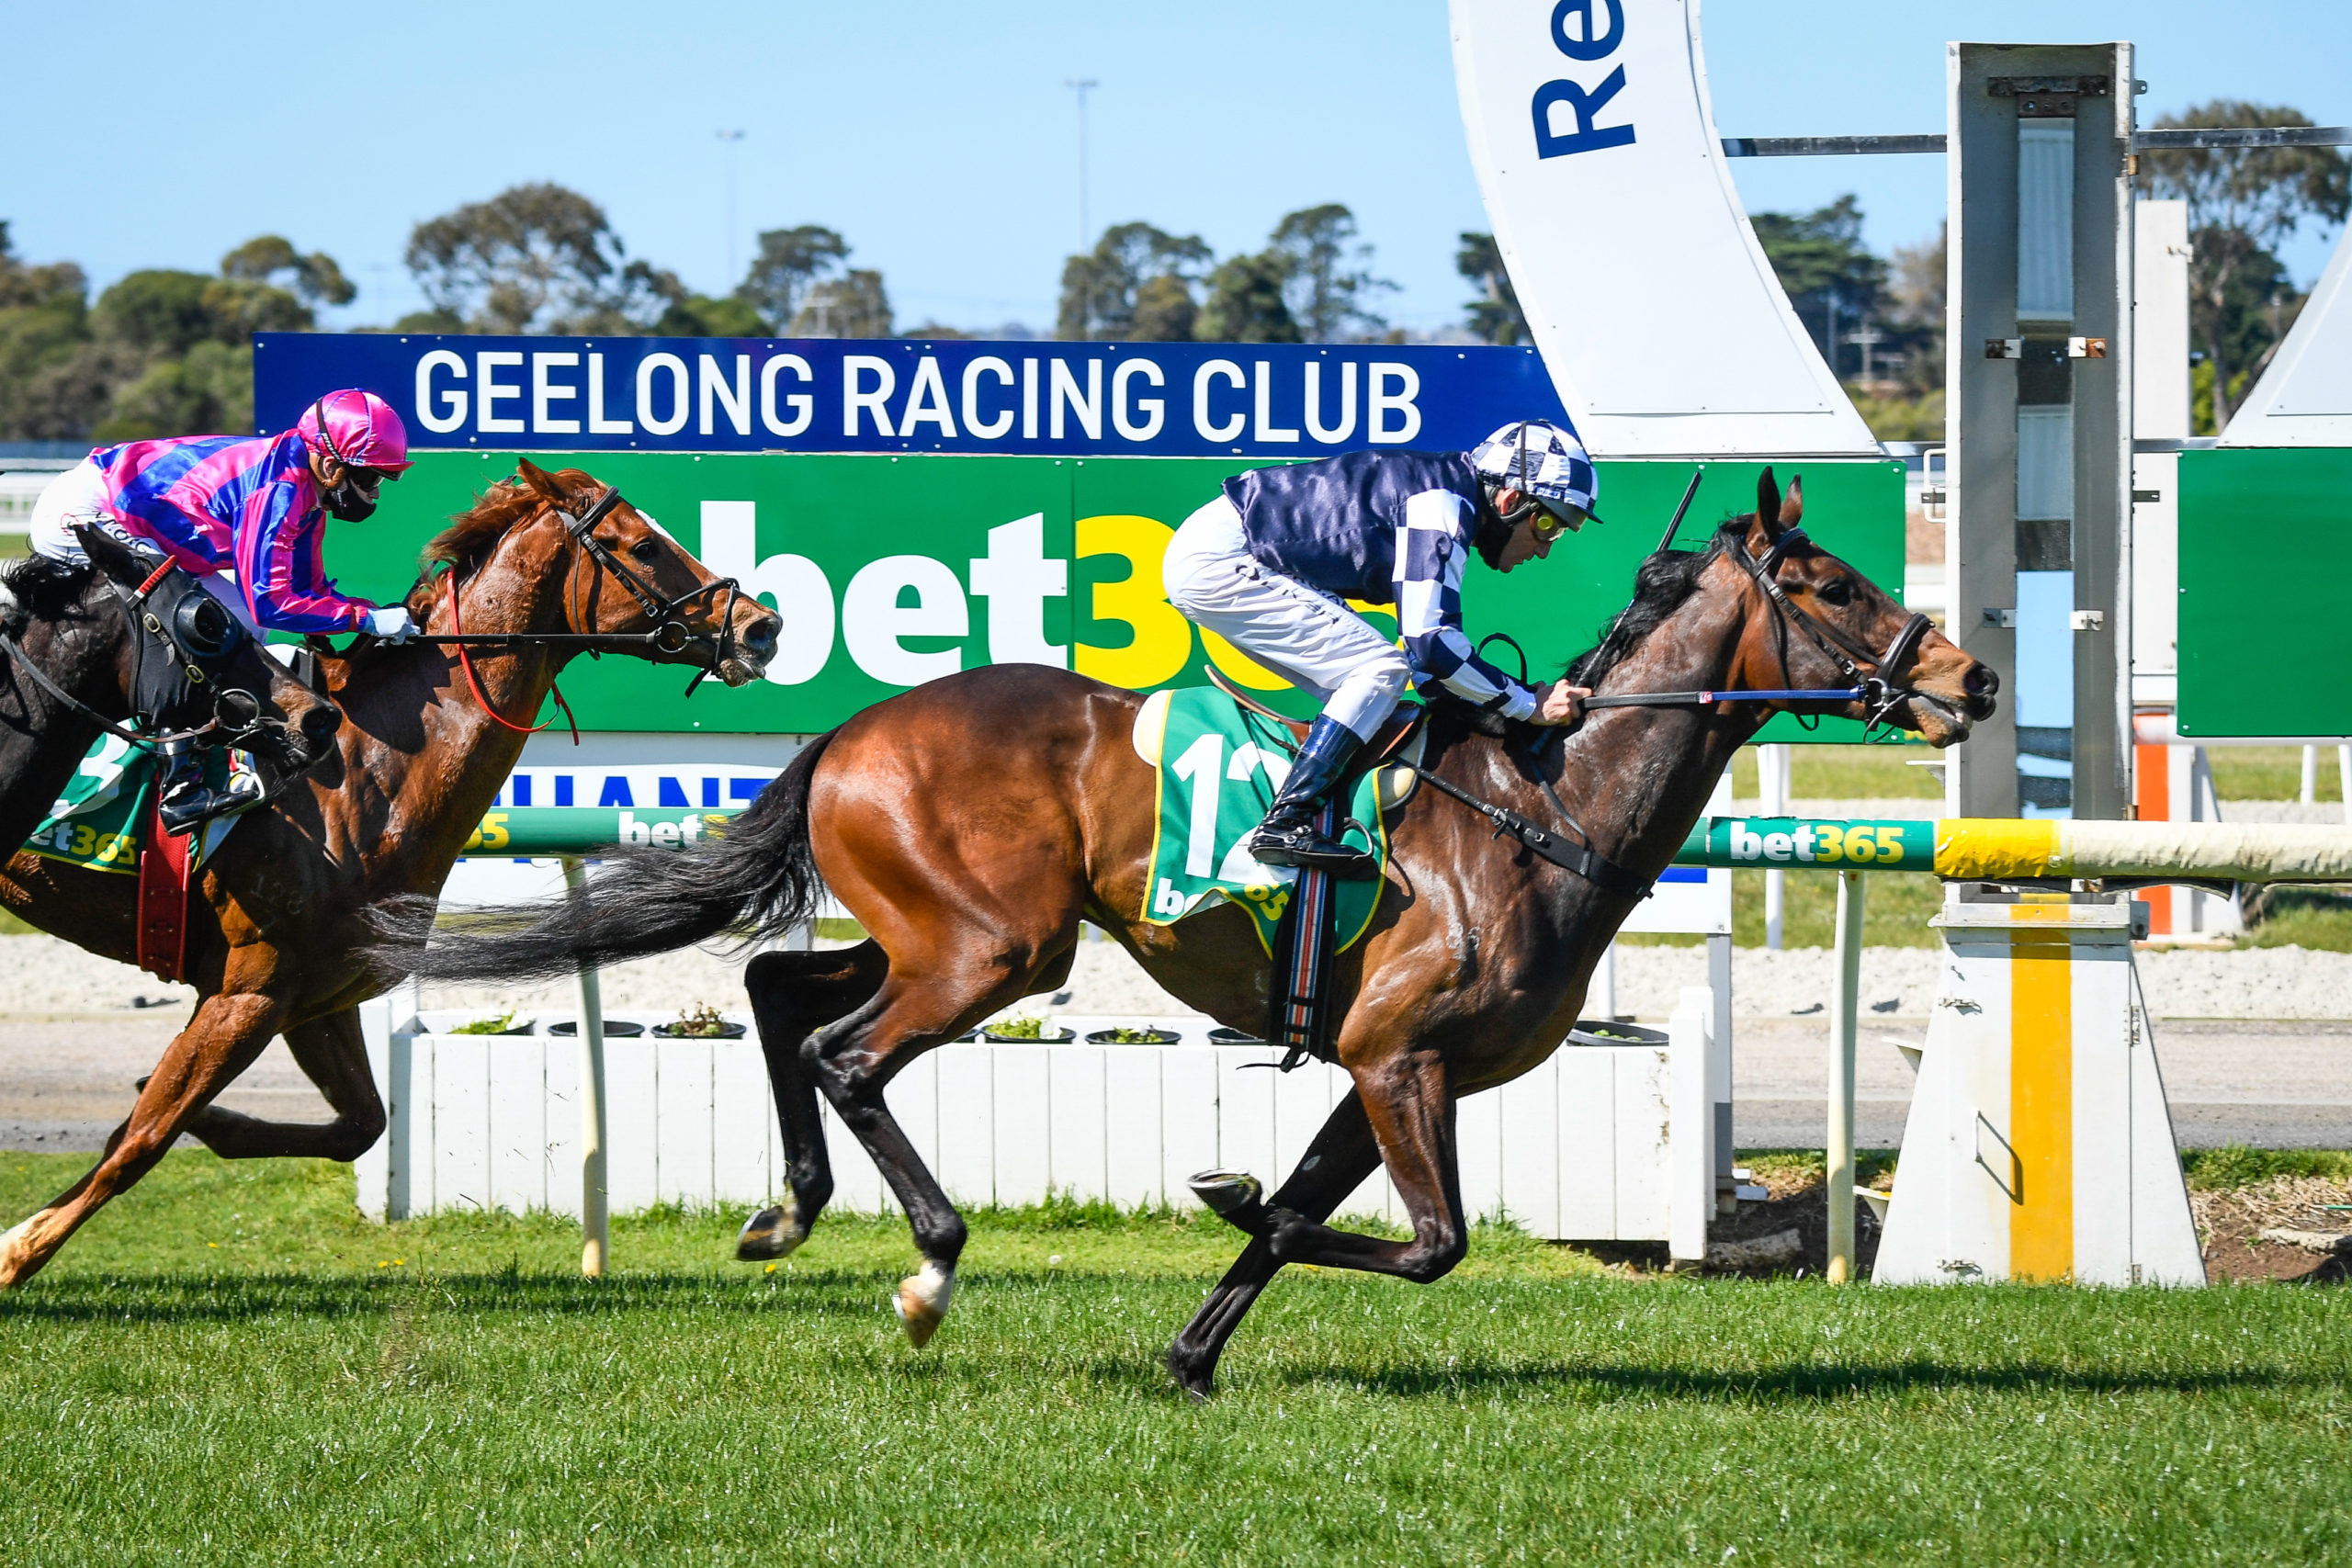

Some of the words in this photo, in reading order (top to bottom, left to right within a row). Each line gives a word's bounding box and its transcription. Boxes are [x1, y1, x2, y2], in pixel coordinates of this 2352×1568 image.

[414, 349, 814, 437] GEELONG
[842, 355, 1166, 442] RACING
[1193, 359, 1422, 445] CLUB
[1171, 734, 1297, 886] 12
[1729, 821, 1905, 863] bet365
